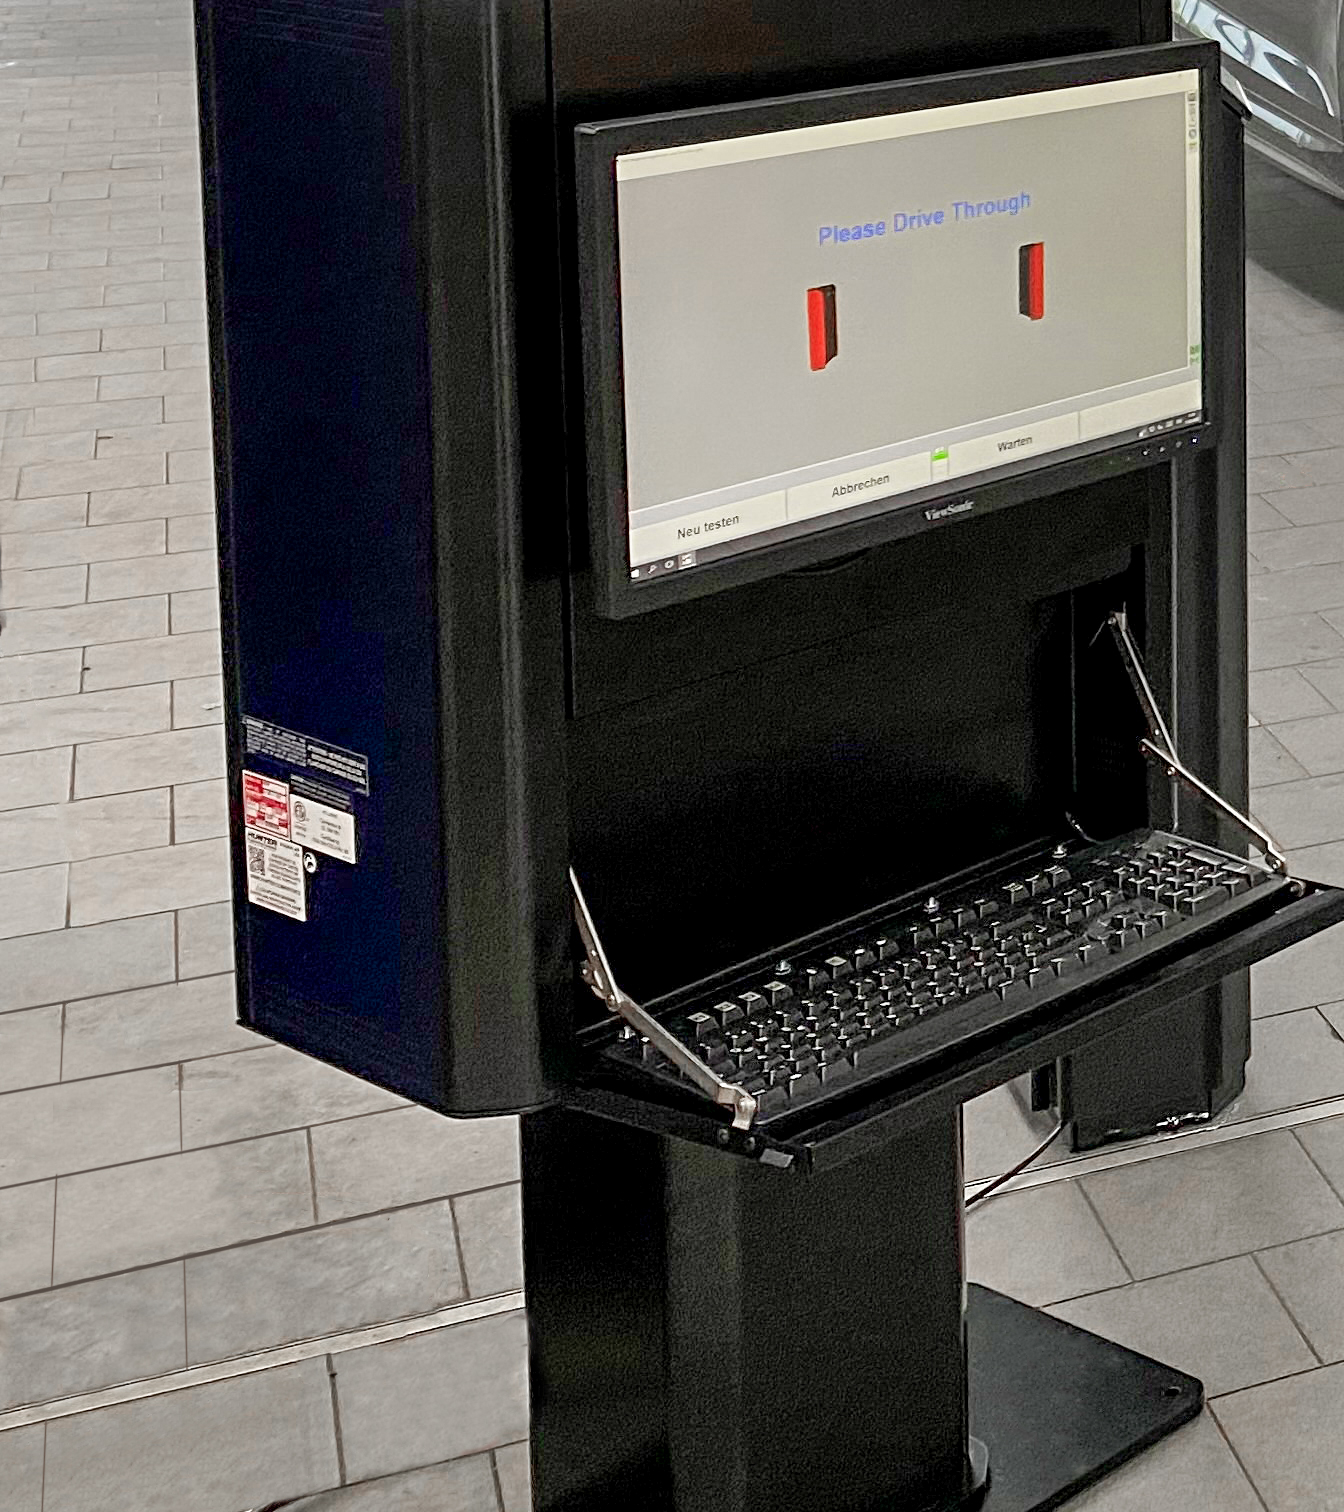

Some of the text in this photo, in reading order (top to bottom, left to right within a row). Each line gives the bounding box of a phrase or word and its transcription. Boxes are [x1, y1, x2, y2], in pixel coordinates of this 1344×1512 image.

[818, 191, 1031, 247] Please Drive Through
[996, 435, 1033, 453] Warten
[831, 474, 890, 498] Abbrechen
[924, 500, 975, 521] ViewSonic
[677, 513, 740, 540] Neu testen
